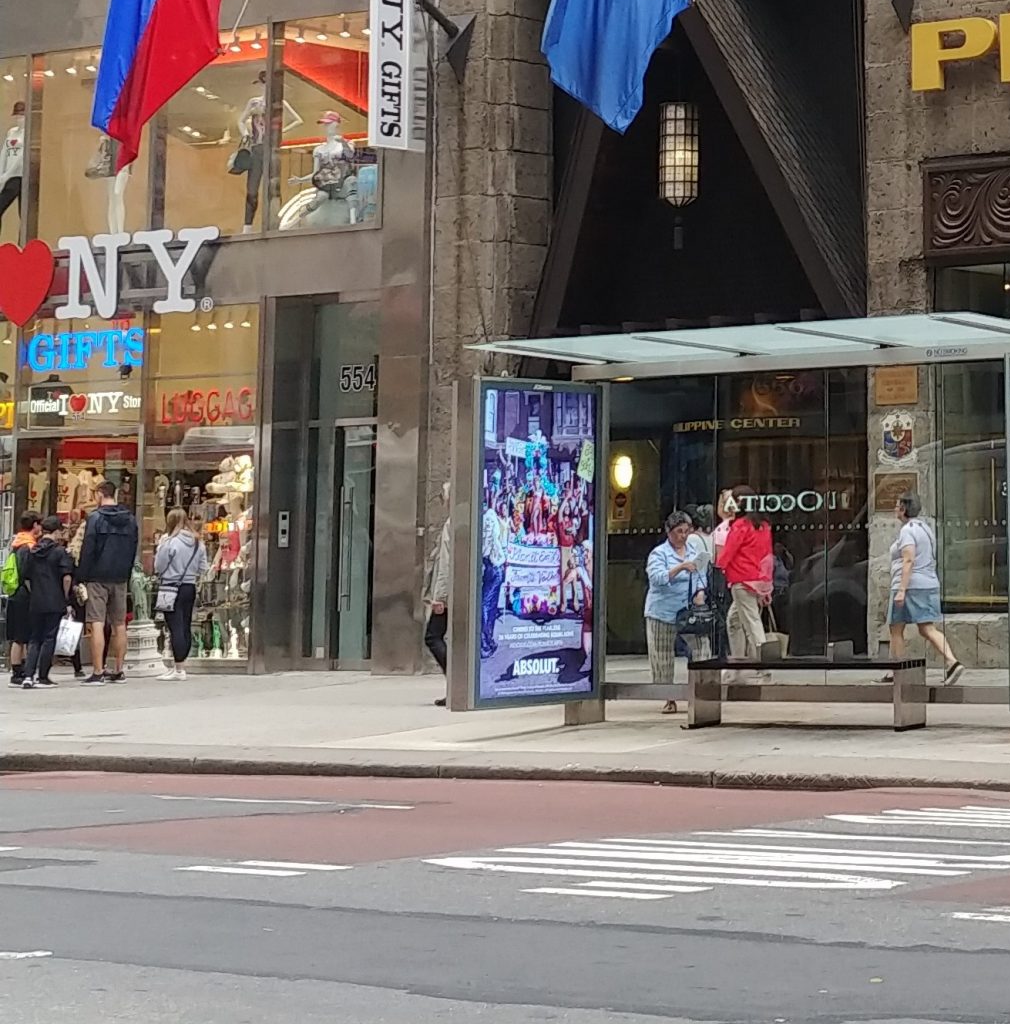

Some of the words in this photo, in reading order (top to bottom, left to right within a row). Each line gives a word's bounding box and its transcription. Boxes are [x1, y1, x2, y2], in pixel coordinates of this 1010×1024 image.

[380, 60, 402, 139] GIFTS
[55, 226, 220, 319] NY
[28, 328, 144, 372] GIFTS
[340, 363, 376, 393] 554
[30, 399, 60, 414] Official
[87, 391, 124, 415] NY
[123, 396, 141, 409] Stor
[160, 386, 254, 425] LUGGAG
[730, 417, 801, 430] CENTER
[512, 657, 560, 676] ABSOLUT.
